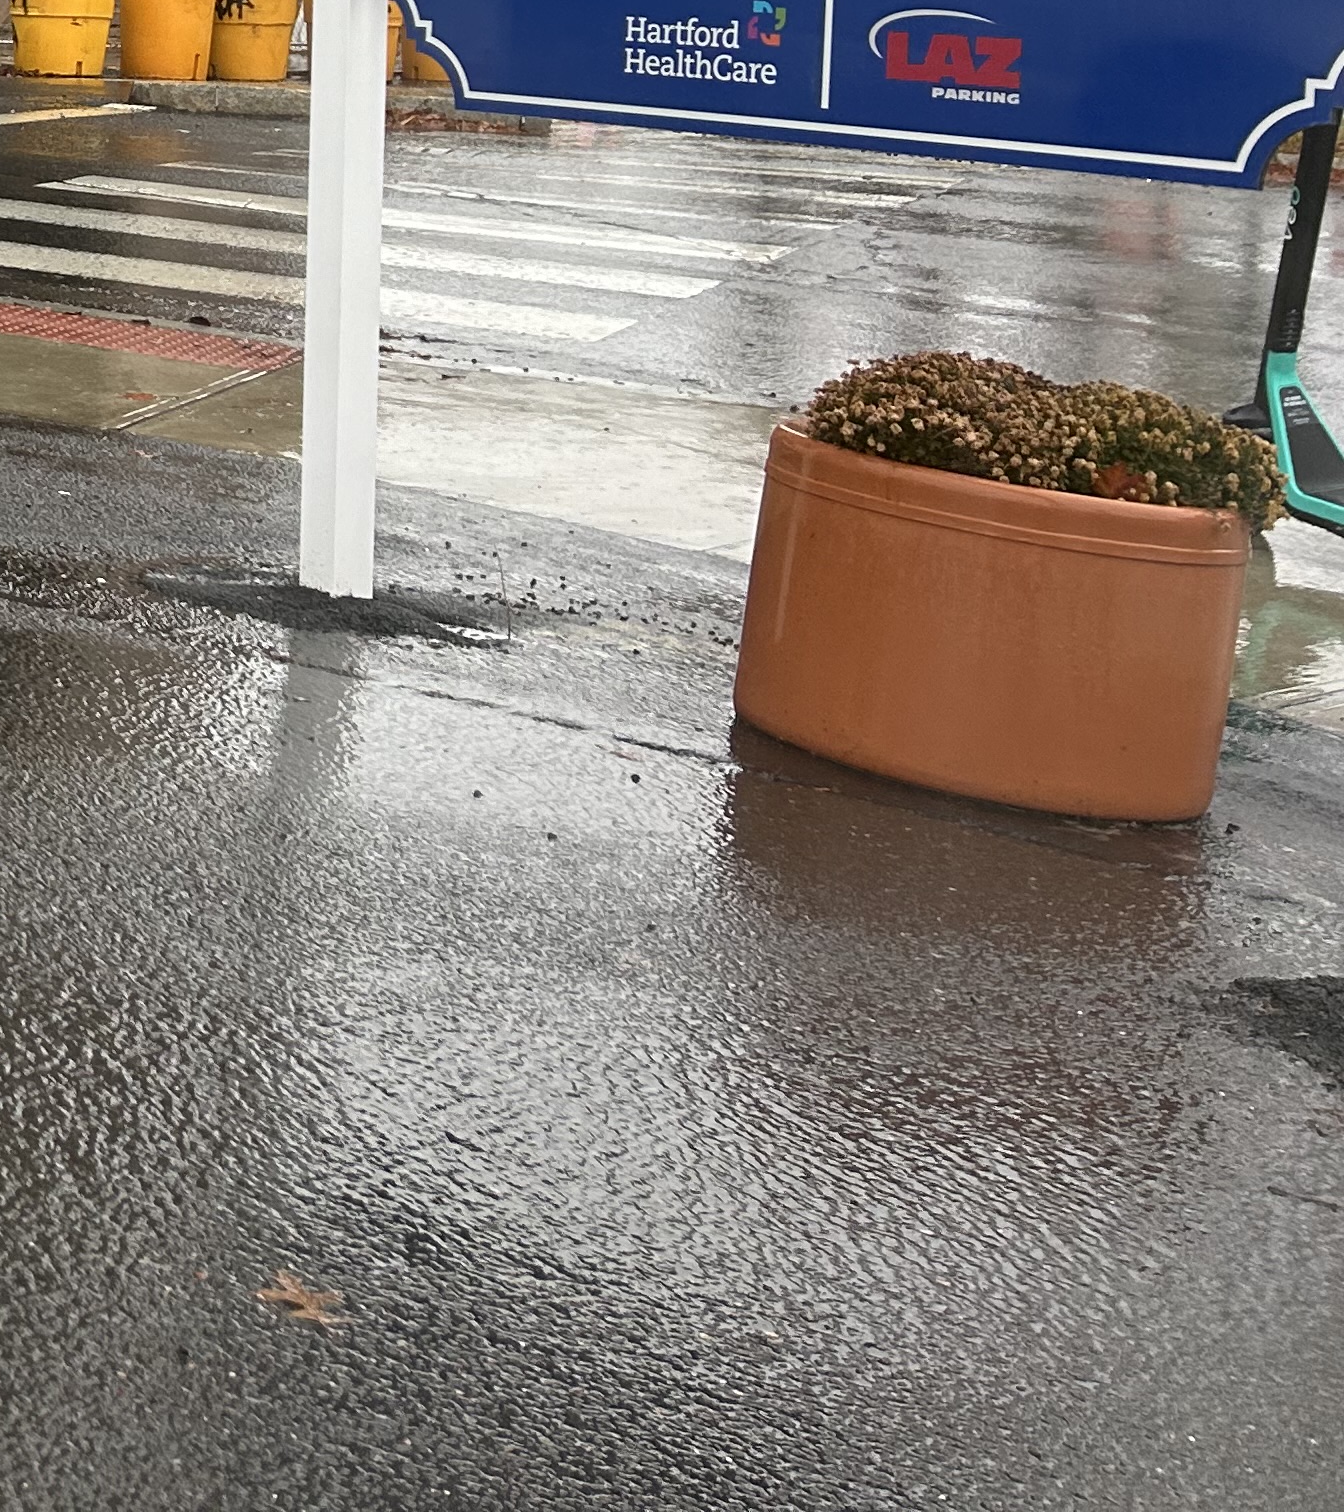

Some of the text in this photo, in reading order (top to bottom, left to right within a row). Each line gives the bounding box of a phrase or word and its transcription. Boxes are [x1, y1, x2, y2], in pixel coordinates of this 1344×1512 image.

[625, 16, 740, 49] Hartford
[624, 48, 778, 85] HealthCare
[886, 31, 1022, 89] LAZ
[931, 87, 1020, 105] PARKING
